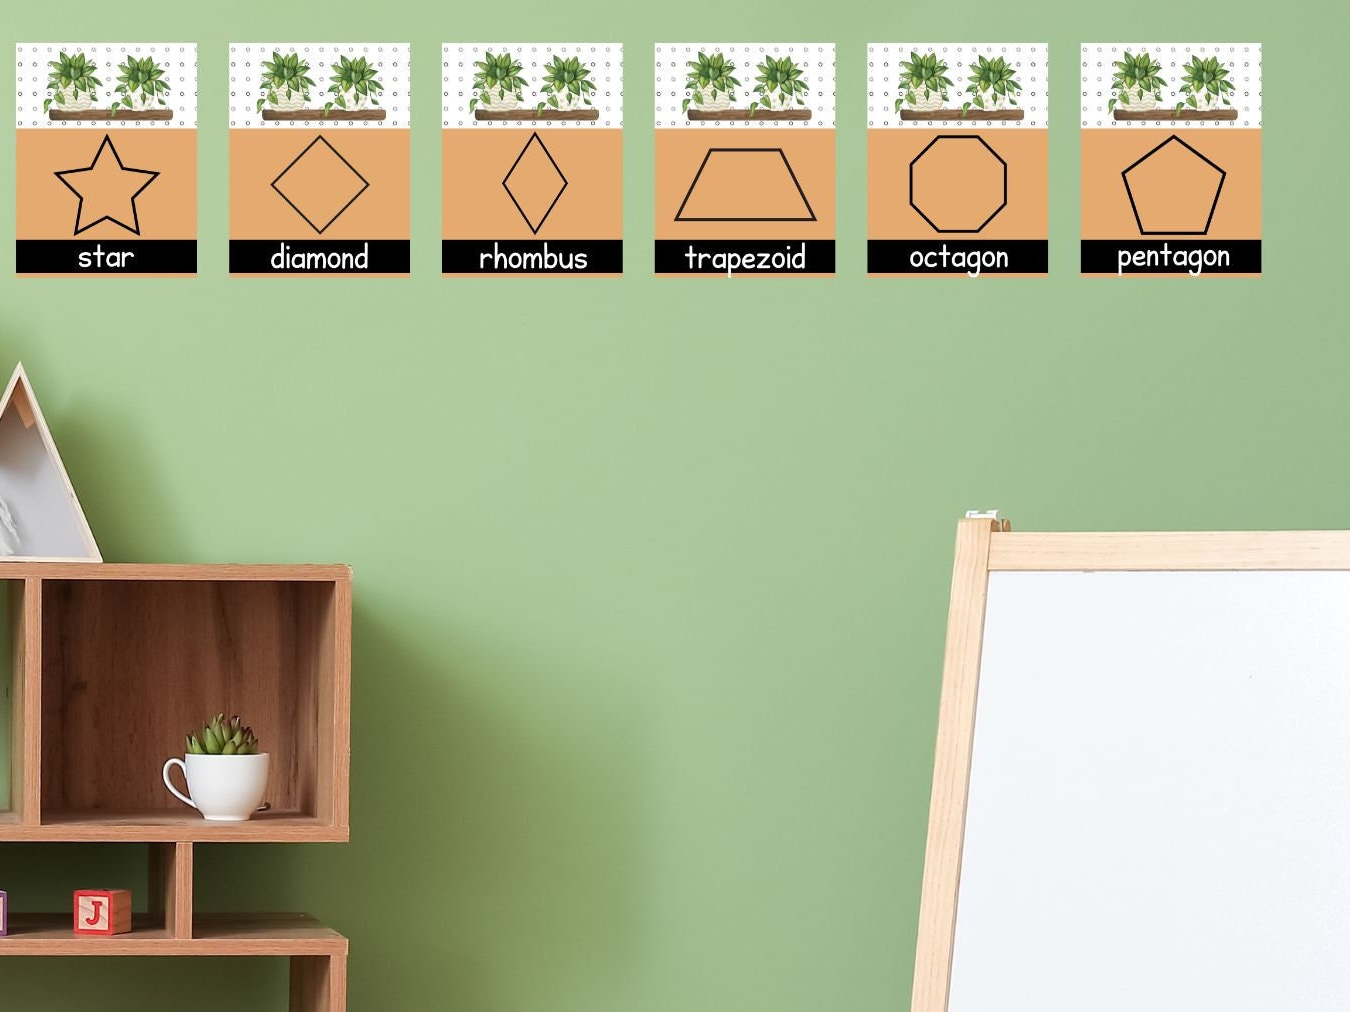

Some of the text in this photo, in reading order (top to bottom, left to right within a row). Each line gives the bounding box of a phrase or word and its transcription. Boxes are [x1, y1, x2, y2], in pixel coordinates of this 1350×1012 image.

[78, 243, 135, 268] star
[270, 242, 369, 270] diamond
[479, 241, 588, 270] rhombus
[684, 242, 806, 278] trapezoid
[909, 243, 1009, 278] octagon
[1117, 242, 1230, 277] pentagon
[85, 900, 103, 926] J
